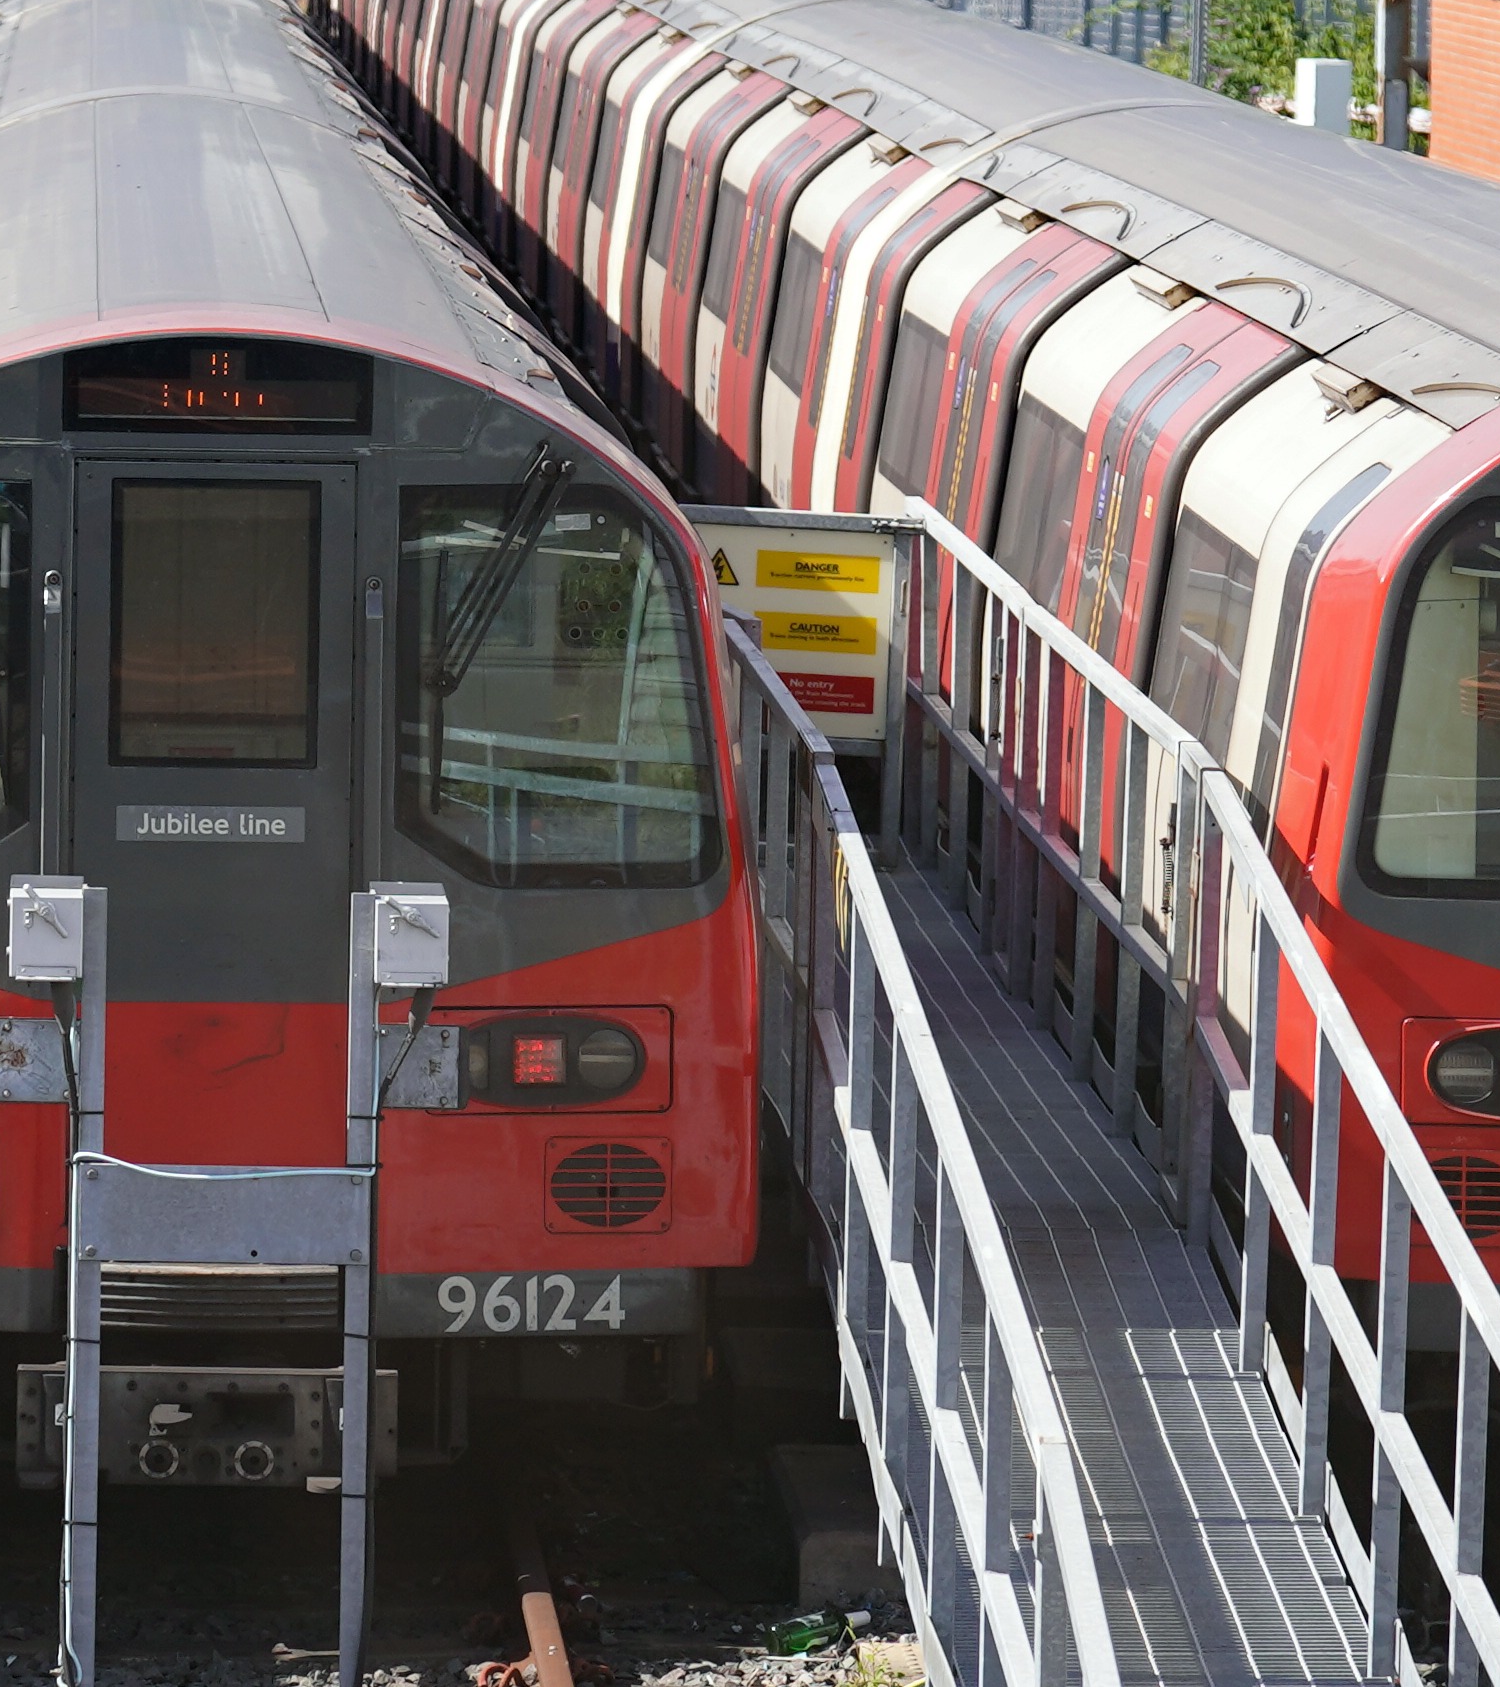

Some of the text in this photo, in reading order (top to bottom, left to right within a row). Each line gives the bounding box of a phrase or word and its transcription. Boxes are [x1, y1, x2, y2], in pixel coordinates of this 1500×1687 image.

[795, 561, 840, 573] DANGER
[789, 622, 840, 633] CAUTION
[789, 678, 835, 691] No entry
[136, 812, 286, 836] Jubilee line
[437, 1273, 626, 1333] 96124
